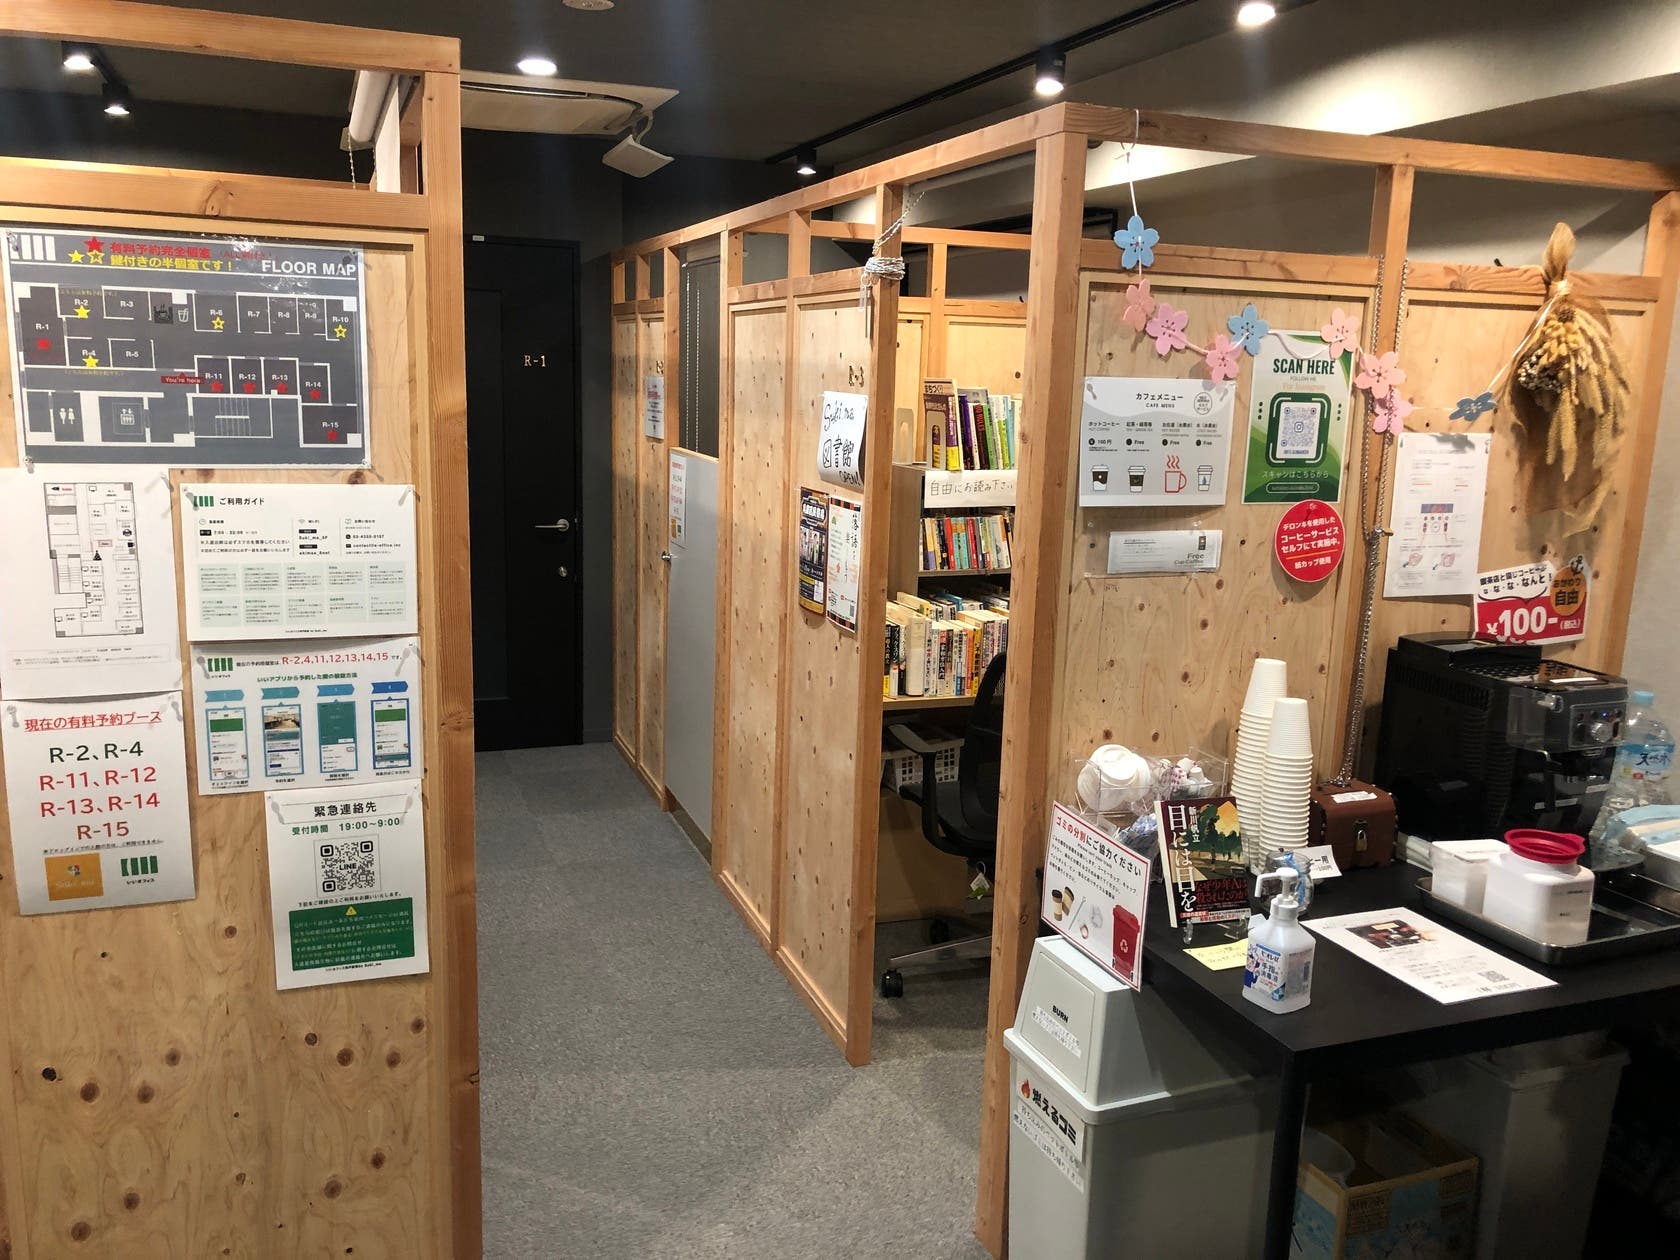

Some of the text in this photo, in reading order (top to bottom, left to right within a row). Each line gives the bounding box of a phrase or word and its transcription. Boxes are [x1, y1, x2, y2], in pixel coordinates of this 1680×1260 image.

[110, 241, 212, 259] 有料予約完全個室
[110, 254, 233, 272] 鍵付きの半個室です！
[261, 259, 357, 277] FLOOR MAP
[74, 298, 89, 306] R-2
[120, 300, 134, 308] R-3
[247, 310, 261, 318] R-7
[524, 354, 546, 368] R-1
[1273, 358, 1336, 375] SCAN HERE
[205, 372, 223, 380] R-11
[238, 373, 256, 381] R-12
[305, 381, 322, 389] R-14
[1135, 392, 1184, 401] カフェメニュー
[322, 421, 339, 429] R-15
[822, 433, 855, 469] 図書館
[1261, 470, 1330, 480] スキャンはこちらから
[930, 479, 1014, 497] 自由にお読み下さい
[219, 497, 266, 507] ご利用ガイド
[1280, 526, 1340, 544] コーヒーサービス
[1187, 552, 1205, 560] Free
[1294, 556, 1332, 570] 紙カップ使用
[1555, 590, 1580, 606] 自由
[23, 710, 163, 732] 現在の有料予約ブース
[313, 801, 378, 818] 緊急連絡先
[76, 821, 130, 841] R-15
[291, 824, 330, 837] 受付時間
[1188, 806, 1201, 843] 新川帆立
[338, 862, 357, 871] LINE
[1052, 1004, 1069, 1024] BURN
[1032, 1088, 1077, 1147] 燃えるゴミ
